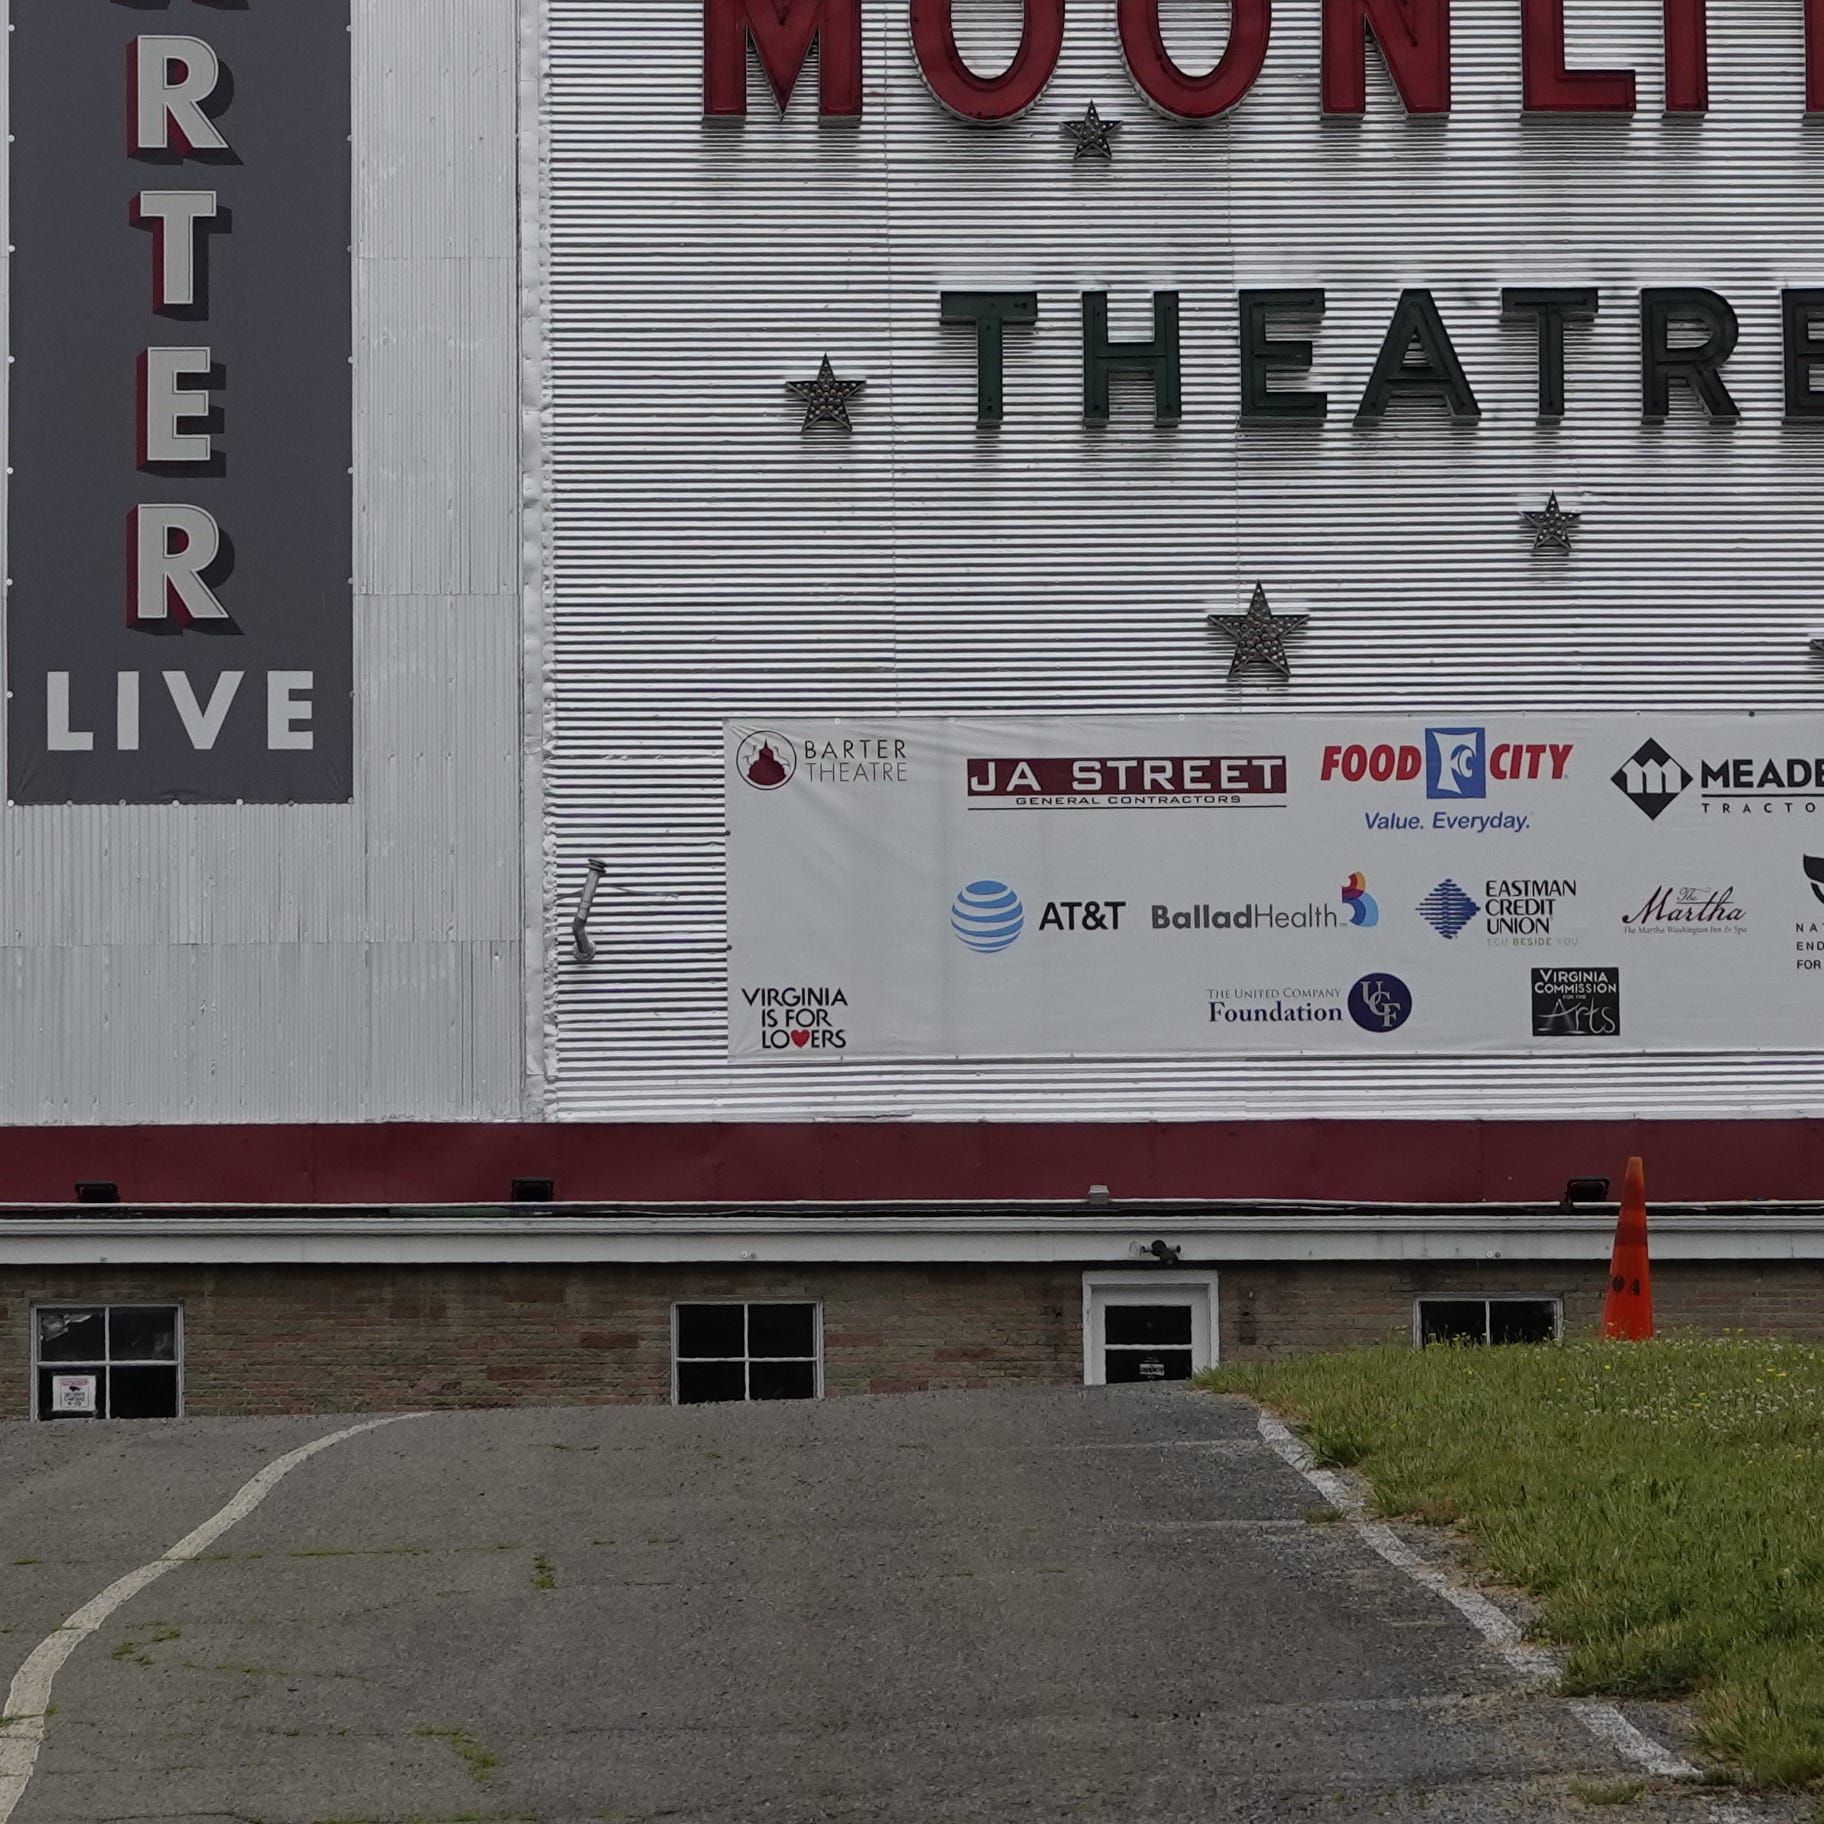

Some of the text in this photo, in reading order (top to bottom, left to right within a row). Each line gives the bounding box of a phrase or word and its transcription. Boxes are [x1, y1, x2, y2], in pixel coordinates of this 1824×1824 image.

[44, 669, 316, 753] LIVE
[804, 739, 907, 760] BARTER
[804, 762, 909, 783] THEATRE
[1320, 743, 1423, 782] FOOD
[1489, 743, 1575, 781] CITY
[970, 759, 1284, 793] JA STREET
[1015, 794, 1242, 806] GENERAL CONTRACTORS
[1364, 811, 1531, 834] Value. Everyday.
[1485, 879, 1577, 898] EASTMAN
[1038, 900, 1127, 931] AT&T
[1484, 898, 1557, 917] CREDIT
[1622, 885, 1748, 925] Martha
[1487, 916, 1551, 935] UNION
[1512, 937, 1553, 946] BESIDE
[1796, 959, 1822, 970] FOR
[1539, 968, 1609, 983] VIRGINIA
[740, 986, 849, 1007] VIRGINIA
[1207, 987, 1343, 1000] THE UNITED COMPANY
[1534, 981, 1617, 994] COMMISSION
[761, 1008, 834, 1028] IS FOR
[1208, 1000, 1344, 1023] Foundation
[1536, 996, 1616, 1035] Arts
